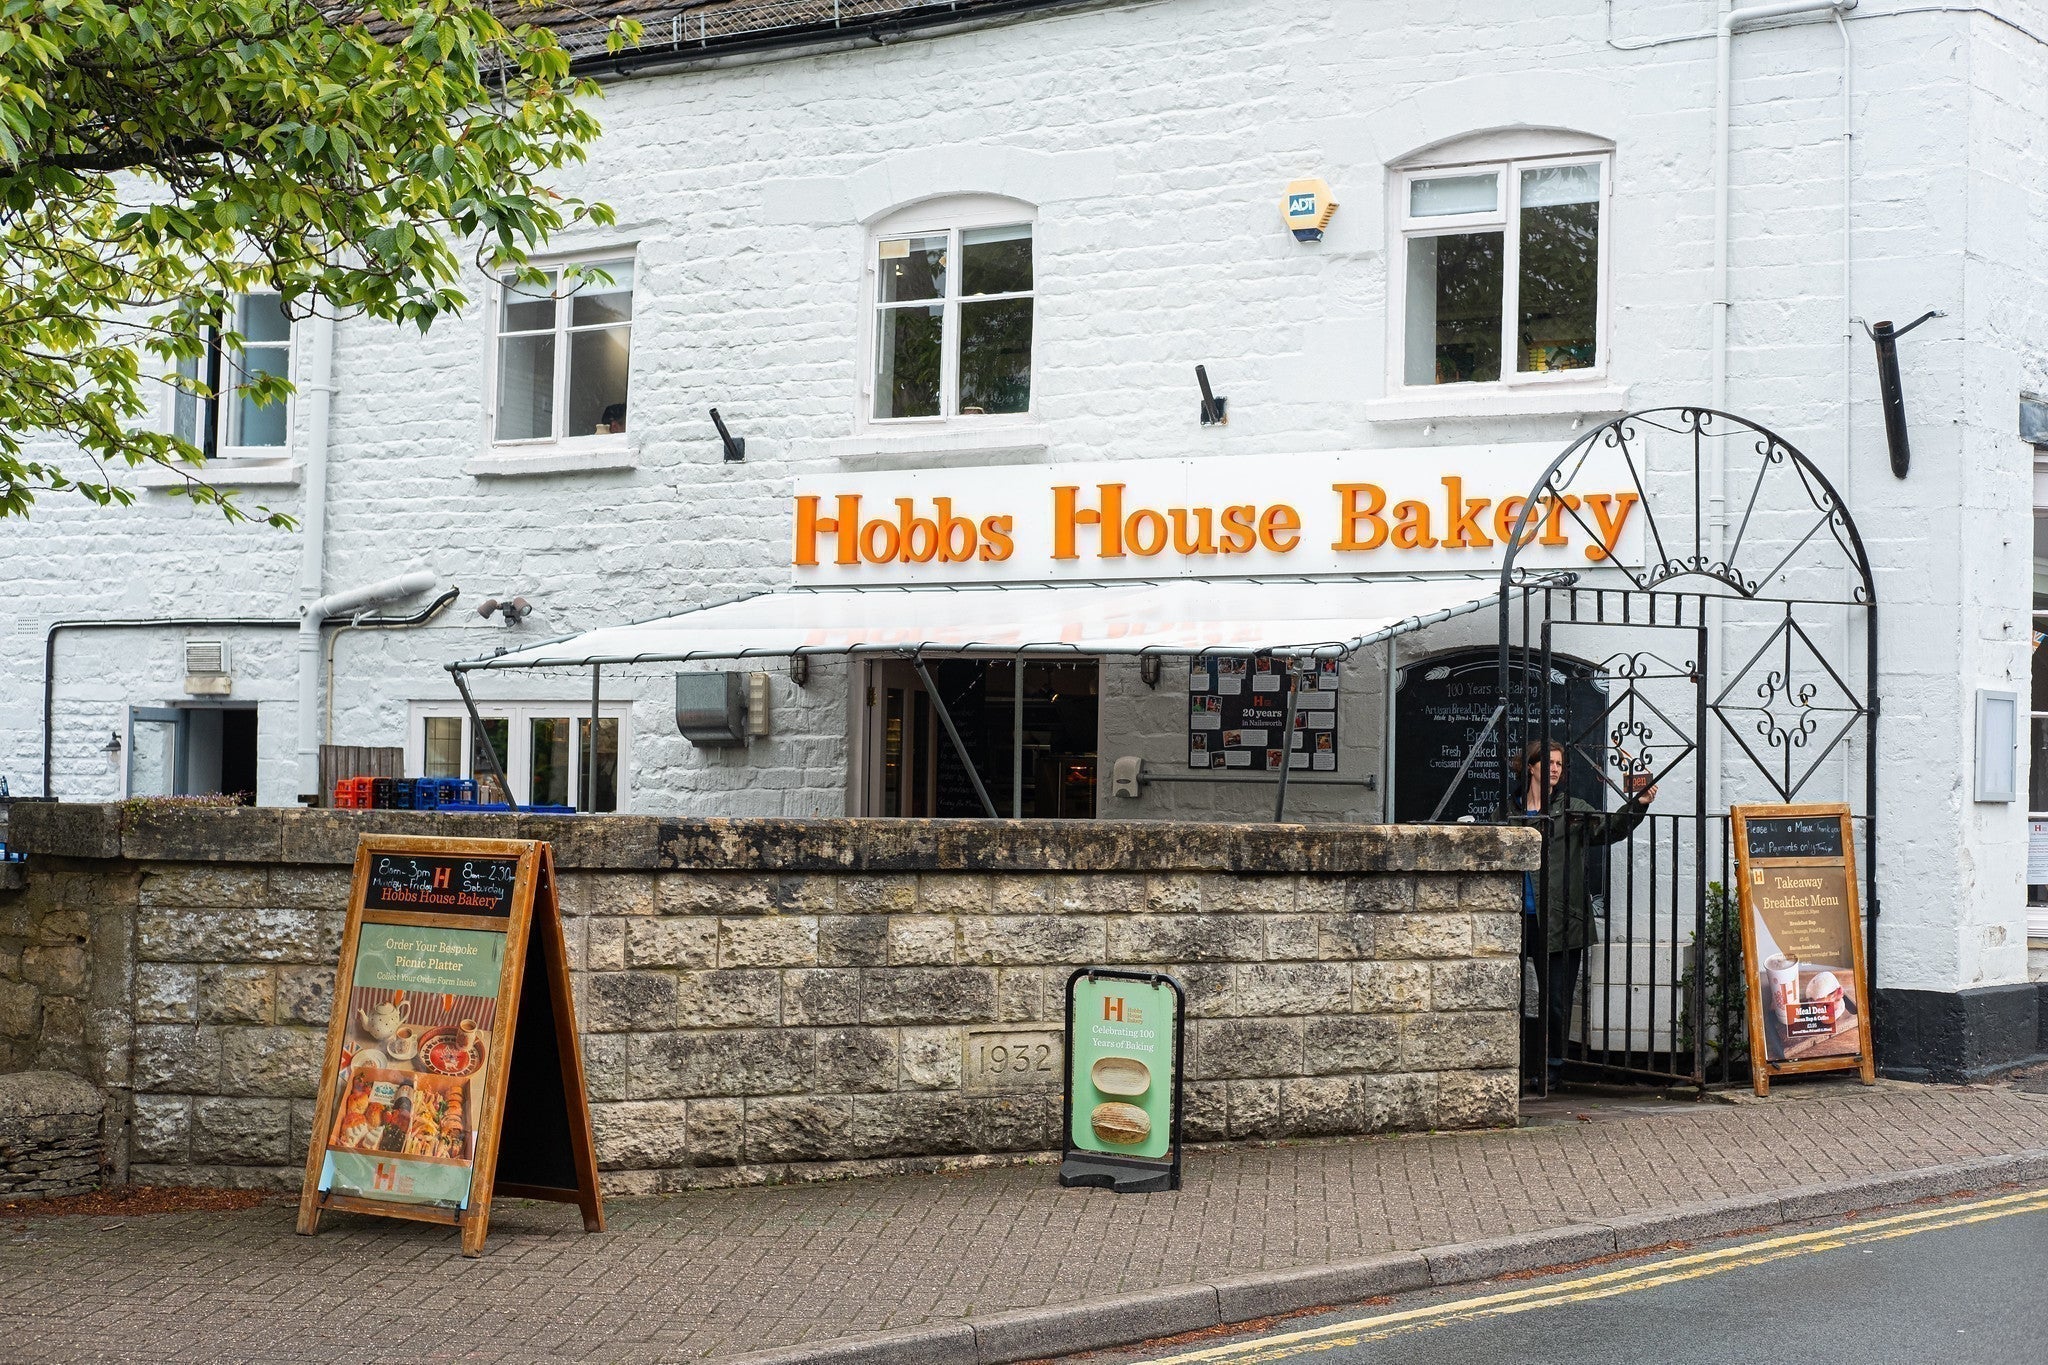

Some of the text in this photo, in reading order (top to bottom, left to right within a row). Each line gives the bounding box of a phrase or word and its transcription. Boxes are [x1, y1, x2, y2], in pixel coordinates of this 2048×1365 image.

[1290, 197, 1315, 212] ADT
[792, 476, 1639, 565] Hobbs House Bakery
[1447, 683, 1464, 697] 100
[1467, 682, 1491, 695] Years
[1508, 681, 1538, 697] Bakng
[1253, 695, 1263, 707] H
[1242, 708, 1282, 719] 20 years
[1425, 705, 1451, 714] Artisan
[1441, 745, 1461, 757] Fresh
[1469, 759, 1499, 768] Cinnamo
[1467, 769, 1500, 779] Breakfas
[1473, 787, 1499, 800] Lunc
[1468, 803, 1488, 815] Soup
[433, 867, 452, 889] H
[1755, 870, 1763, 882] H
[1774, 876, 1823, 889] Takeaway
[463, 880, 504, 900] Saturday
[381, 887, 498, 910] Hobbs House Bakery
[1762, 894, 1839, 909] Breakfast Menu
[386, 938, 478, 956] Order Your Bespoke
[395, 956, 463, 971] Picnic Platter
[376, 972, 477, 987] Collect Your Order Form Inside
[1103, 996, 1125, 1022] H
[1795, 1005, 1827, 1015] Meal Deal
[1092, 1025, 1154, 1038] Celebrating 100
[1092, 1037, 1154, 1053] Years of Baking
[980, 1044, 1051, 1074] 1932
[374, 1162, 397, 1191] H
